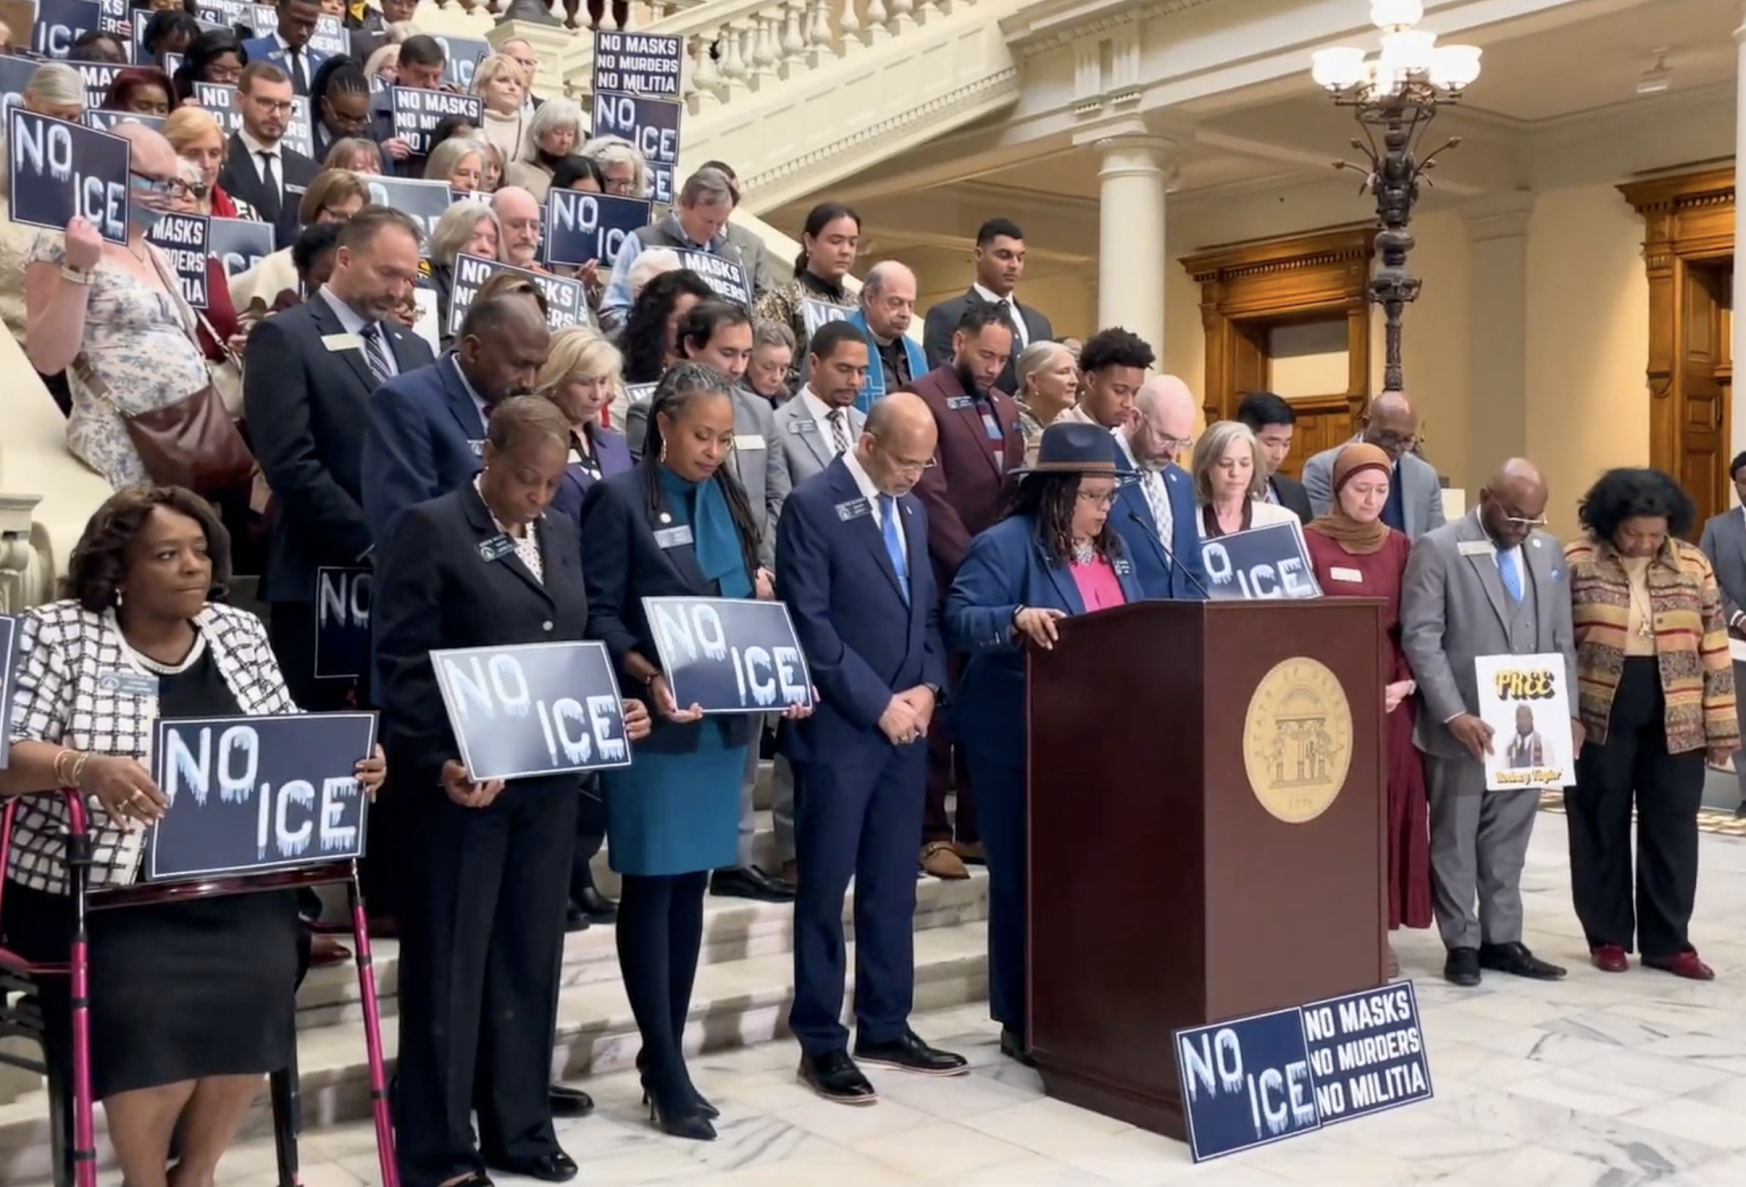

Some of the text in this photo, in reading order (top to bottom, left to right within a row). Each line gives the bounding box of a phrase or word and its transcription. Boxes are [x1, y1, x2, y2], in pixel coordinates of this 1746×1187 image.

[597, 55, 678, 73] NO MURDERS
[601, 34, 677, 55] NO MASKS
[202, 87, 230, 107] NO
[397, 91, 478, 118] NO MASKS
[598, 72, 675, 92] NO MILITIA
[396, 112, 416, 128] NO
[597, 94, 635, 132] NO
[16, 115, 72, 182] NO
[74, 171, 125, 238] ICE
[553, 191, 598, 235] NO
[153, 217, 204, 245] MASKS
[685, 252, 740, 283] MASKS
[1237, 557, 1313, 599] ICE
[655, 604, 727, 662] NO
[444, 654, 530, 722] NO
[730, 646, 807, 707] ICE
[537, 695, 625, 766] ICE
[165, 725, 260, 808] NO
[257, 776, 358, 861] ICE
[1304, 989, 1411, 1042] NO MASKS
[1181, 1027, 1244, 1102] NO
[1338, 1026, 1421, 1072] MURDERS
[1247, 1060, 1316, 1140] ICE
[1315, 1061, 1427, 1119] NO MILITIA
